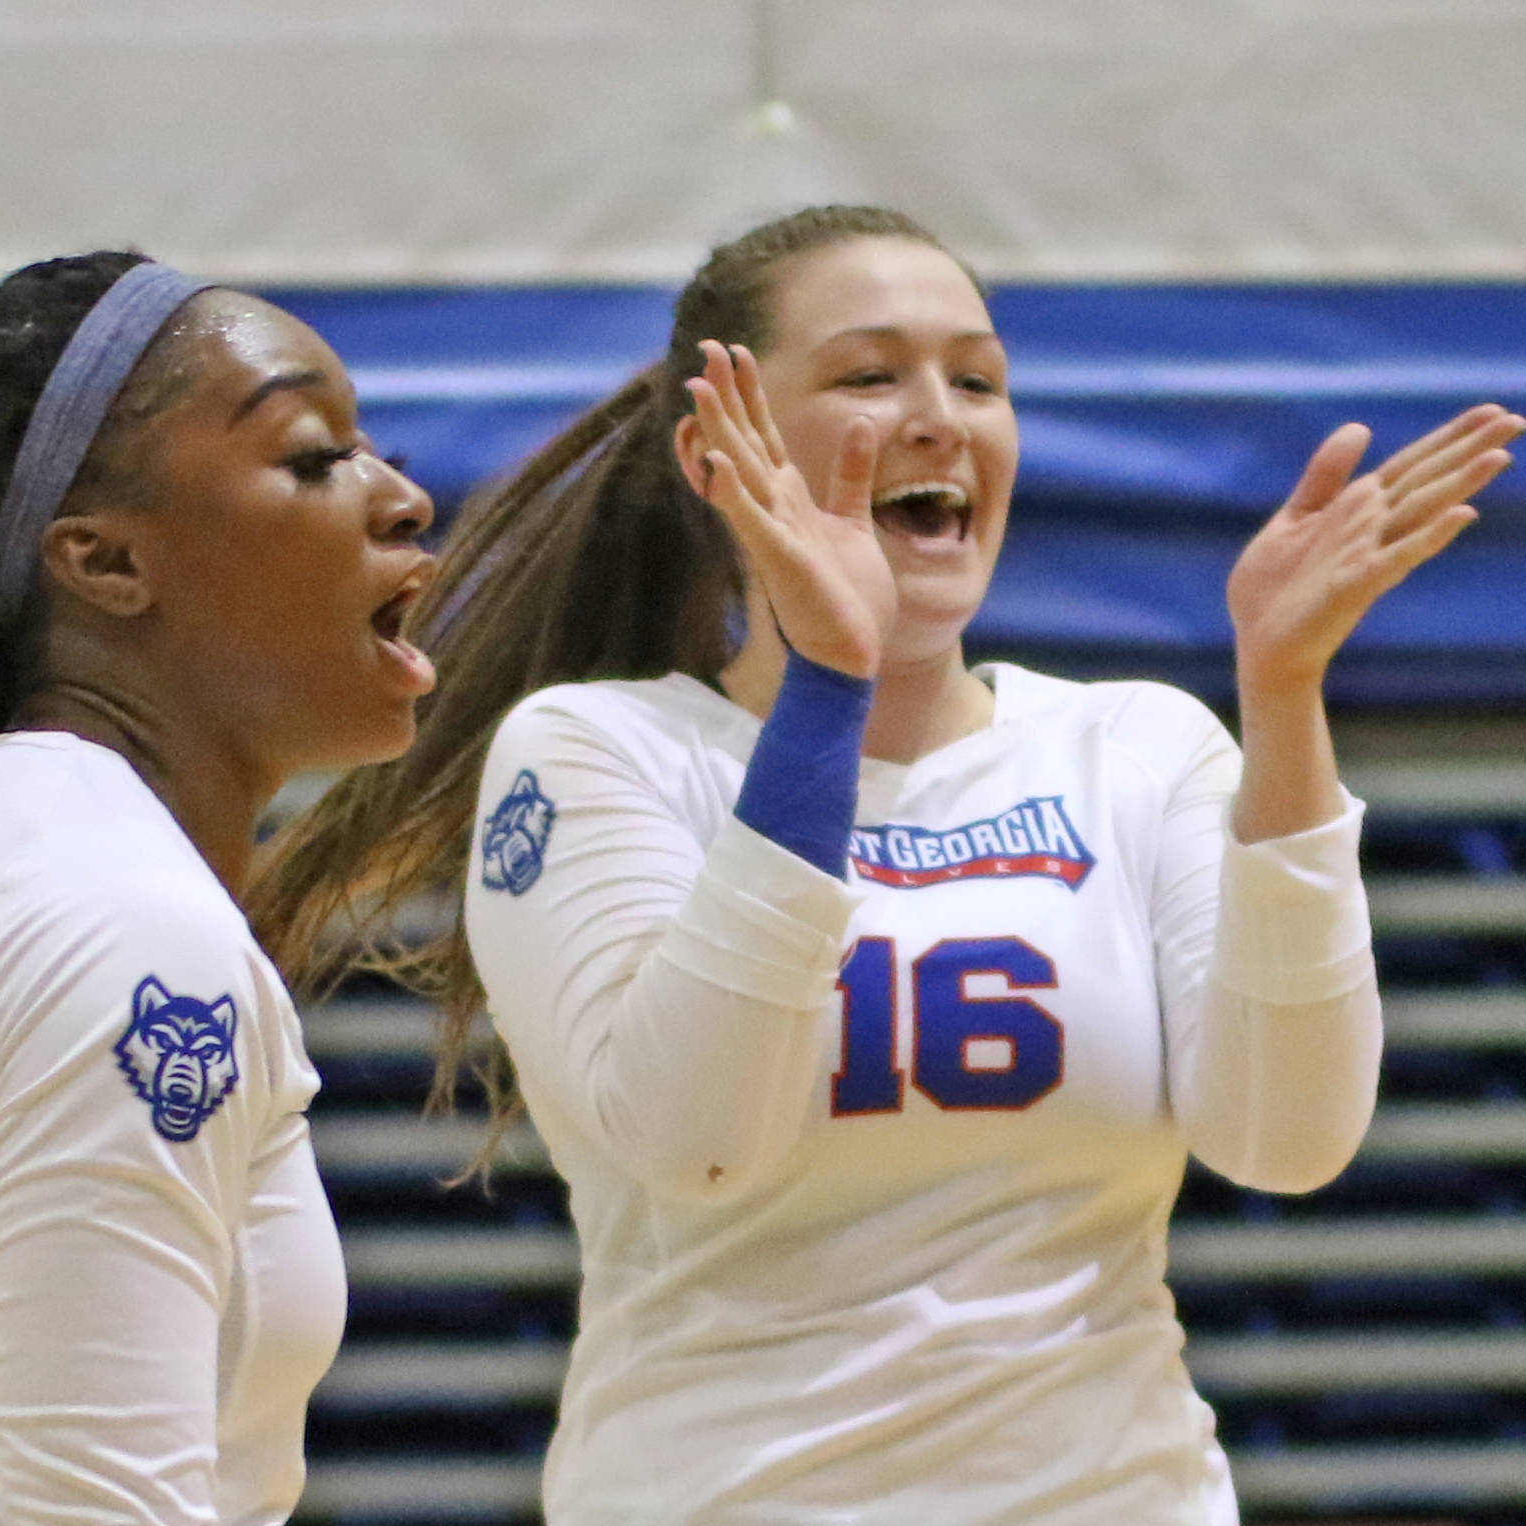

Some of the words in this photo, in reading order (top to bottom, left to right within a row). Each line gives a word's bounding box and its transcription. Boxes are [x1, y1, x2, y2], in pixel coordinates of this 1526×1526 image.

[886, 798, 1082, 869] GEORGIA
[857, 860, 1061, 886] OLVES
[831, 935, 1065, 1118] 16
